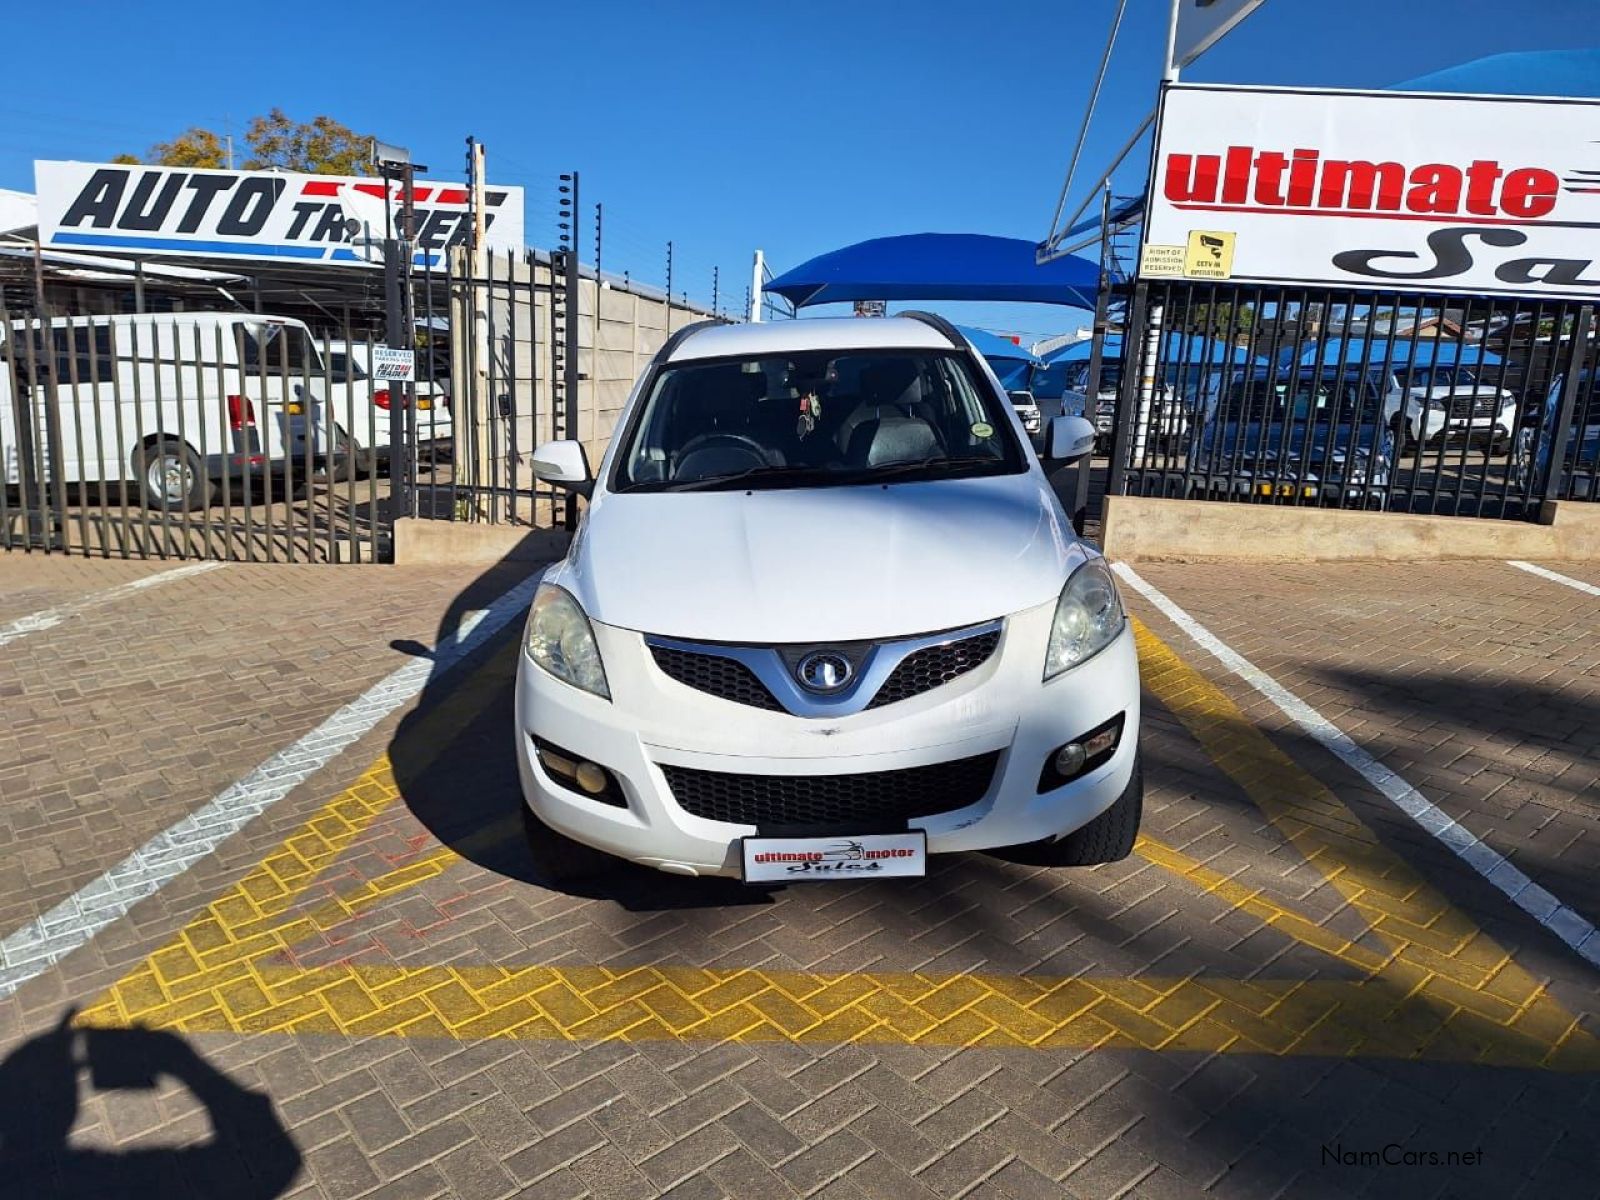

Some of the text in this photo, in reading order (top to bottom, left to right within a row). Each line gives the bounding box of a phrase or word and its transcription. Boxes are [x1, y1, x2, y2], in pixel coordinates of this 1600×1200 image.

[1163, 146, 1559, 218] ultimate
[60, 169, 287, 236] AUTO
[1144, 256, 1183, 264] ADMISSION
[755, 849, 915, 863] ultimate motor
